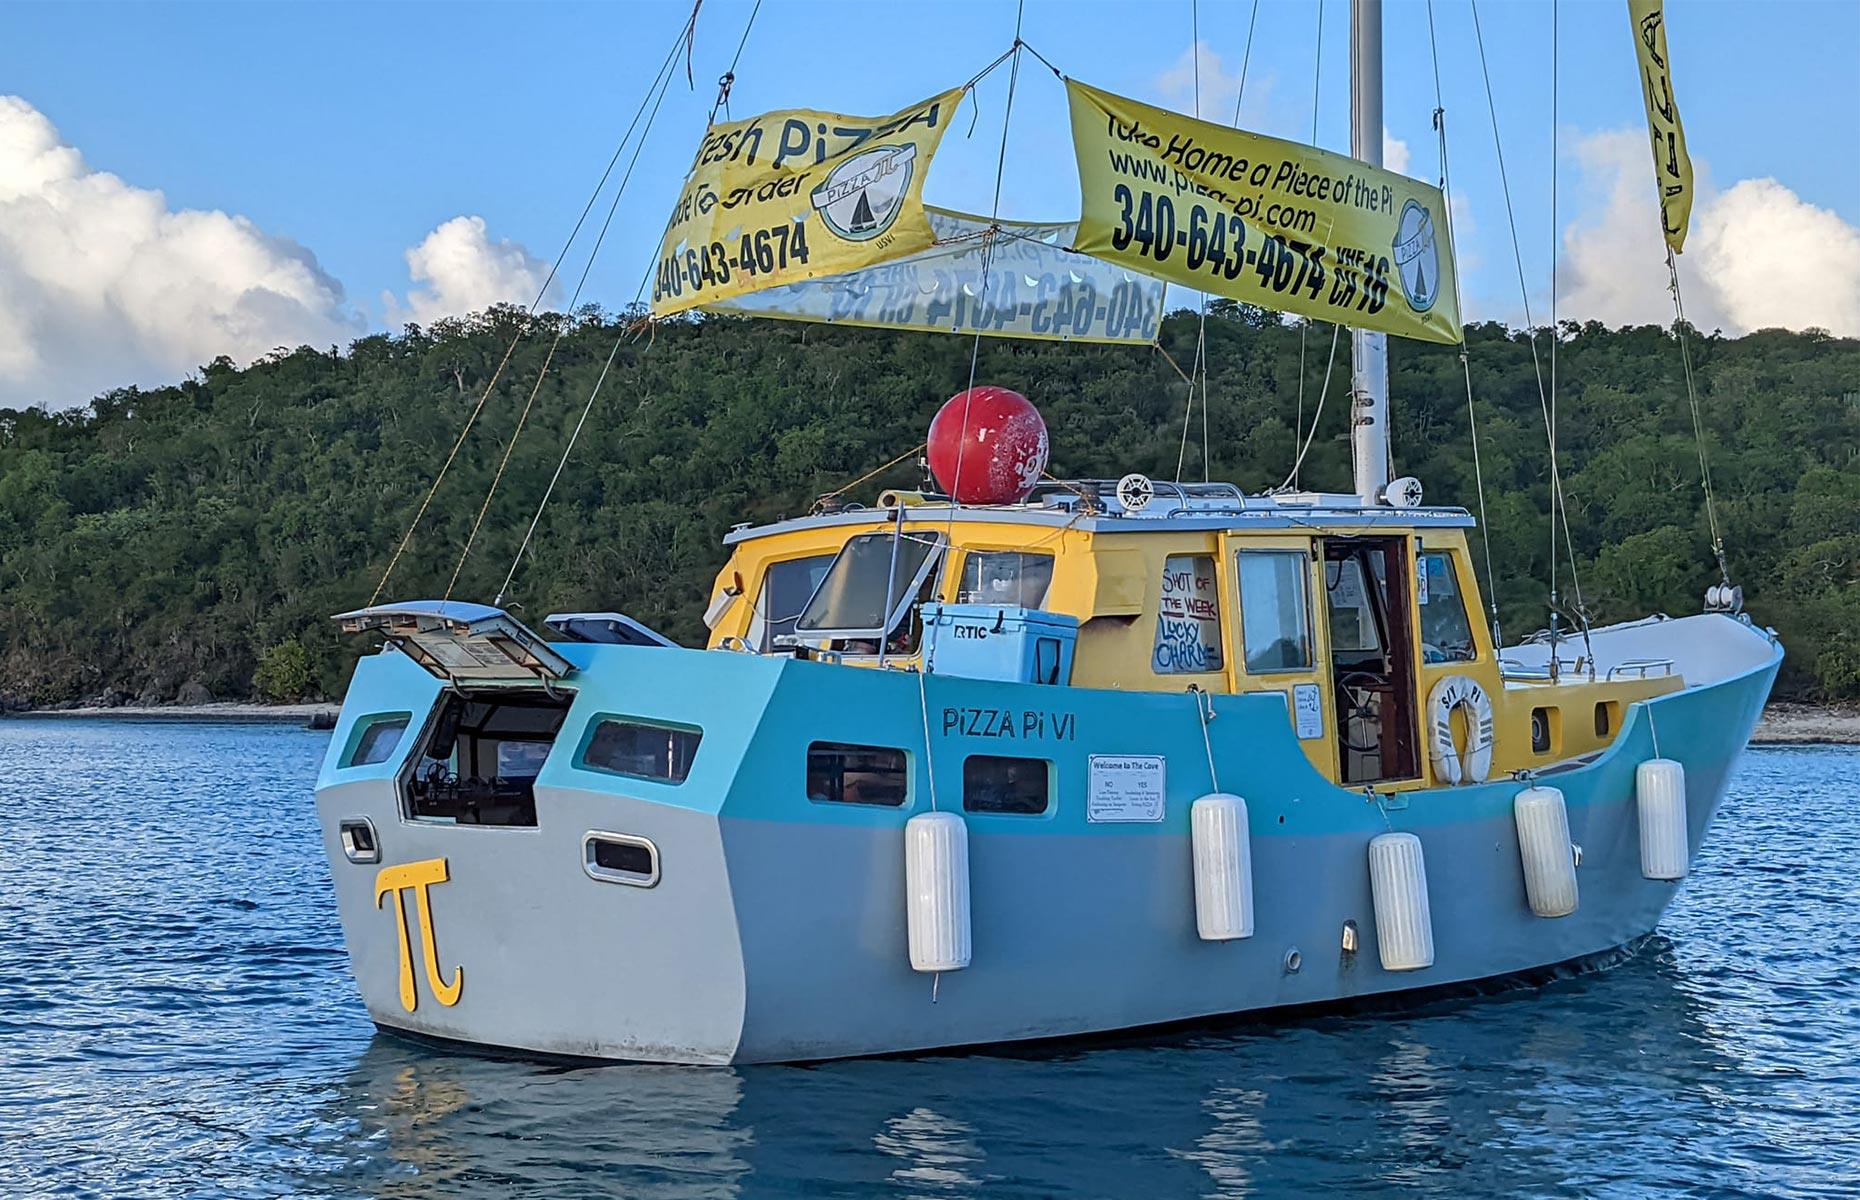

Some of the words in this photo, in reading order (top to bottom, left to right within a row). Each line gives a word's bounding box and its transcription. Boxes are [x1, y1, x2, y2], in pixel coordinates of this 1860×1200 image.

[693, 118, 763, 166] resh
[1161, 134, 1249, 181] Home
[1250, 163, 1271, 187] a
[1271, 161, 1330, 200] Piece
[1333, 174, 1353, 204] of
[1355, 178, 1378, 211] the
[1381, 185, 1393, 216] Pi
[875, 235, 896, 250] USVI
[1113, 184, 1326, 300] 340-643-4674
[655, 221, 809, 302] 340-643-4674
[1328, 267, 1358, 308] CH
[1336, 246, 1365, 267] VHF
[1357, 254, 1390, 315] 16
[1162, 568, 1192, 593] SHOT
[1195, 577, 1210, 591] OF
[1161, 597, 1182, 609] THE
[1184, 597, 1216, 616] WEEK
[954, 625, 987, 639] RTIC
[943, 708, 1015, 738] PiZZA
[1023, 711, 1044, 739] Pi
[1051, 713, 1075, 741] VI
[1093, 761, 1122, 770] Welcome
